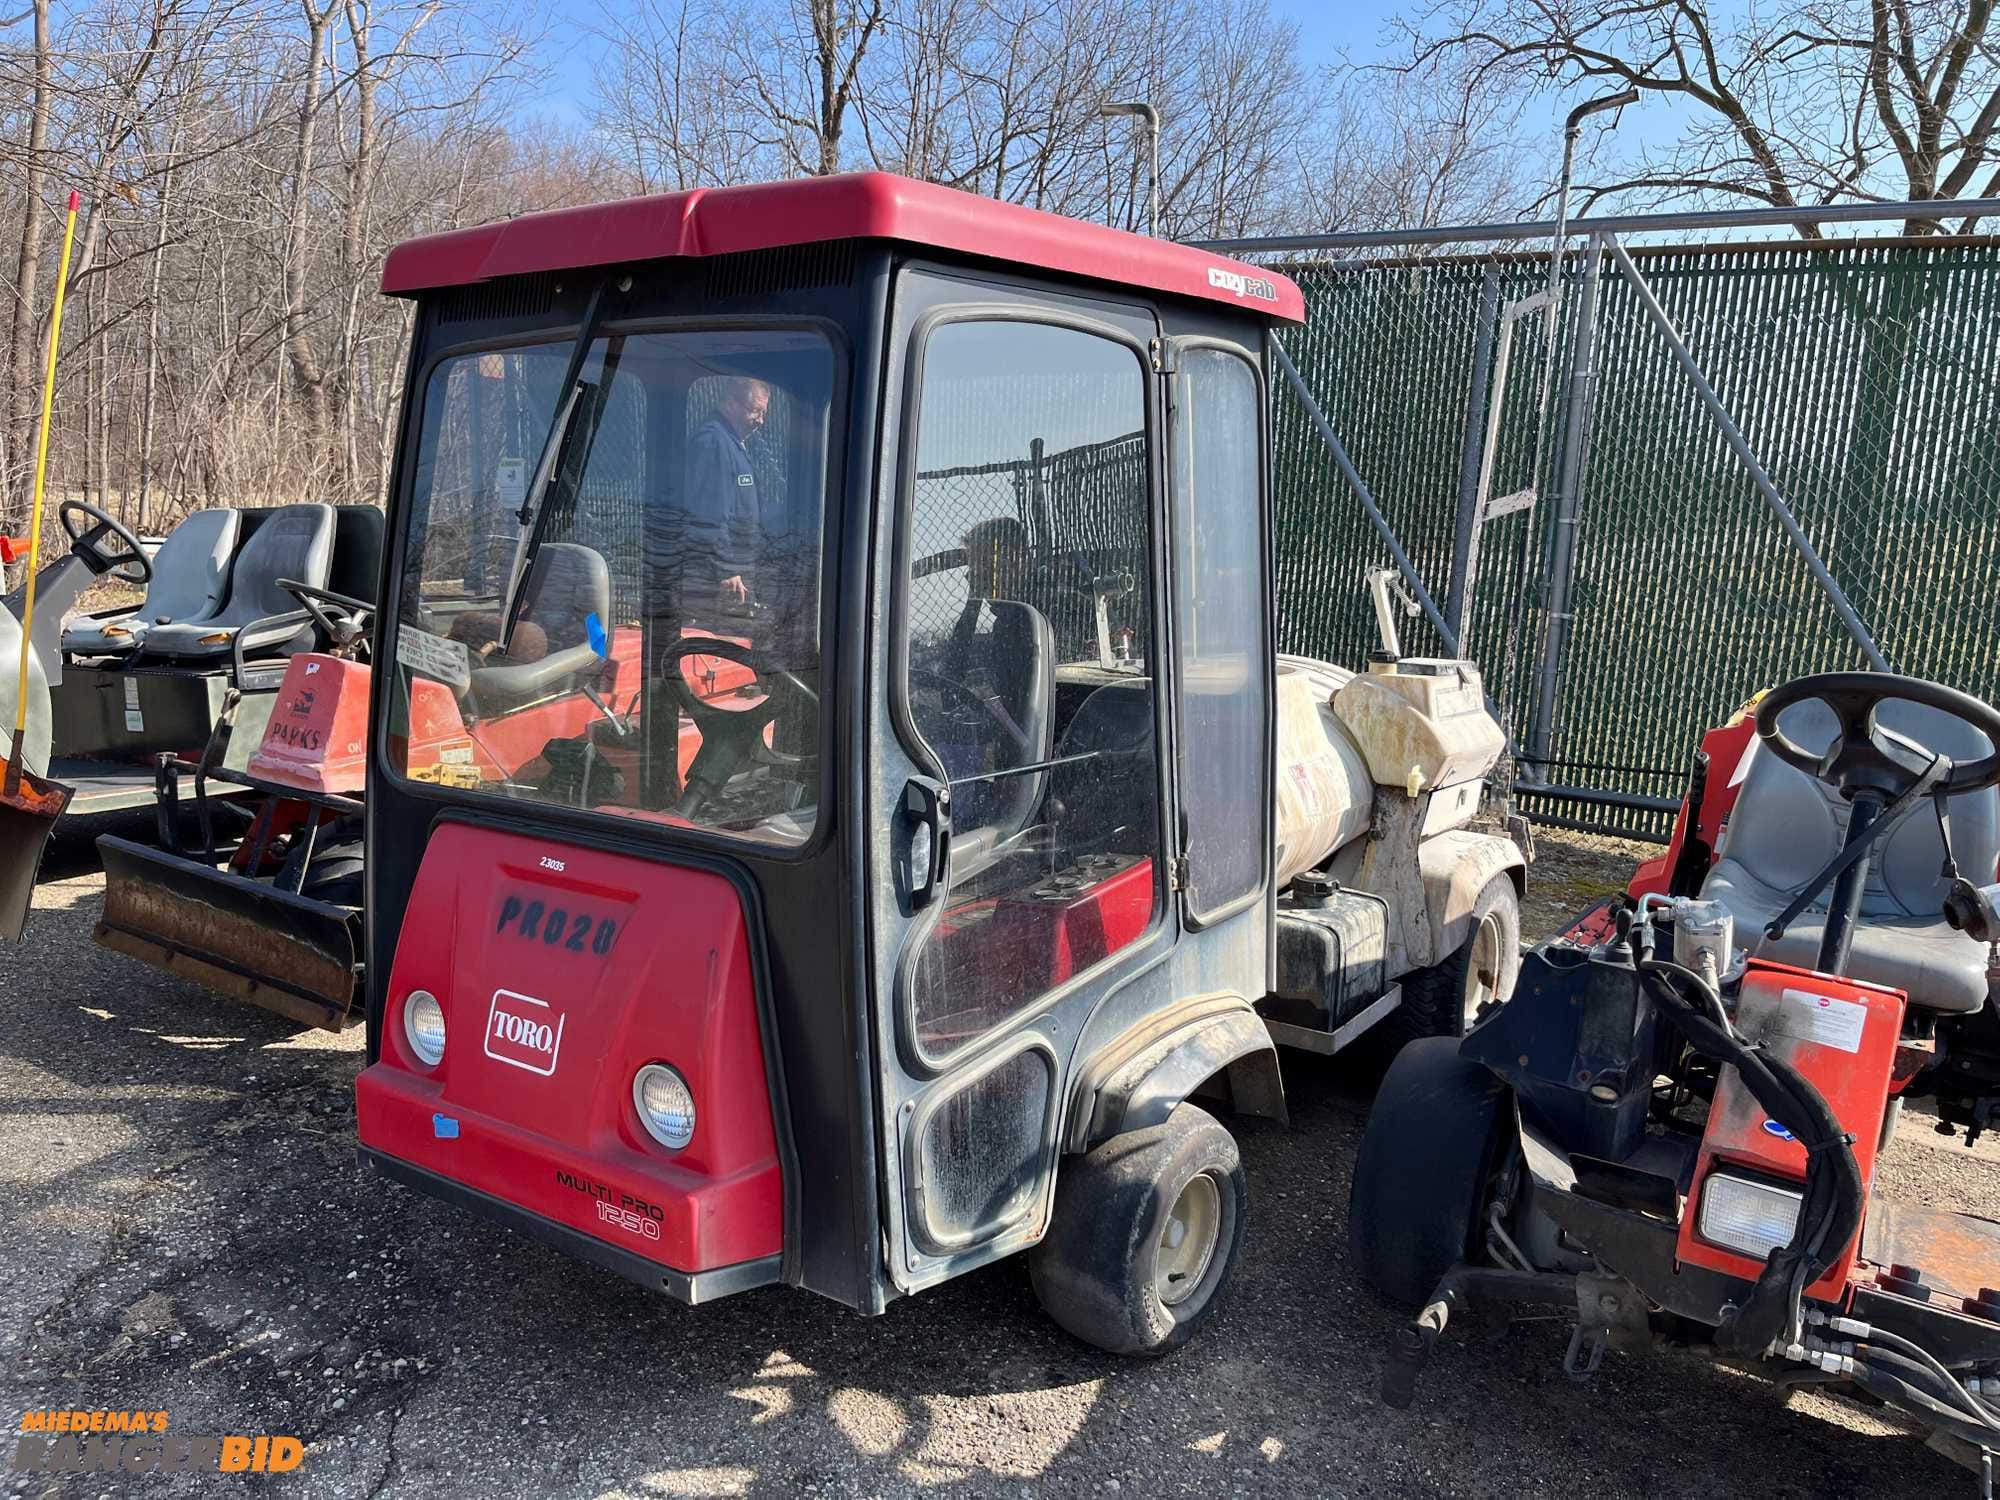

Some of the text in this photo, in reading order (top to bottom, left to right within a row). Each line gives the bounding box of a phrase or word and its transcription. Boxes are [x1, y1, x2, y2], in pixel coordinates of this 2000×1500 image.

[272, 722, 321, 751] PARKS
[539, 856, 565, 872] 23035
[556, 1170, 665, 1222] MULTI PRO
[596, 1200, 660, 1241] 1250
